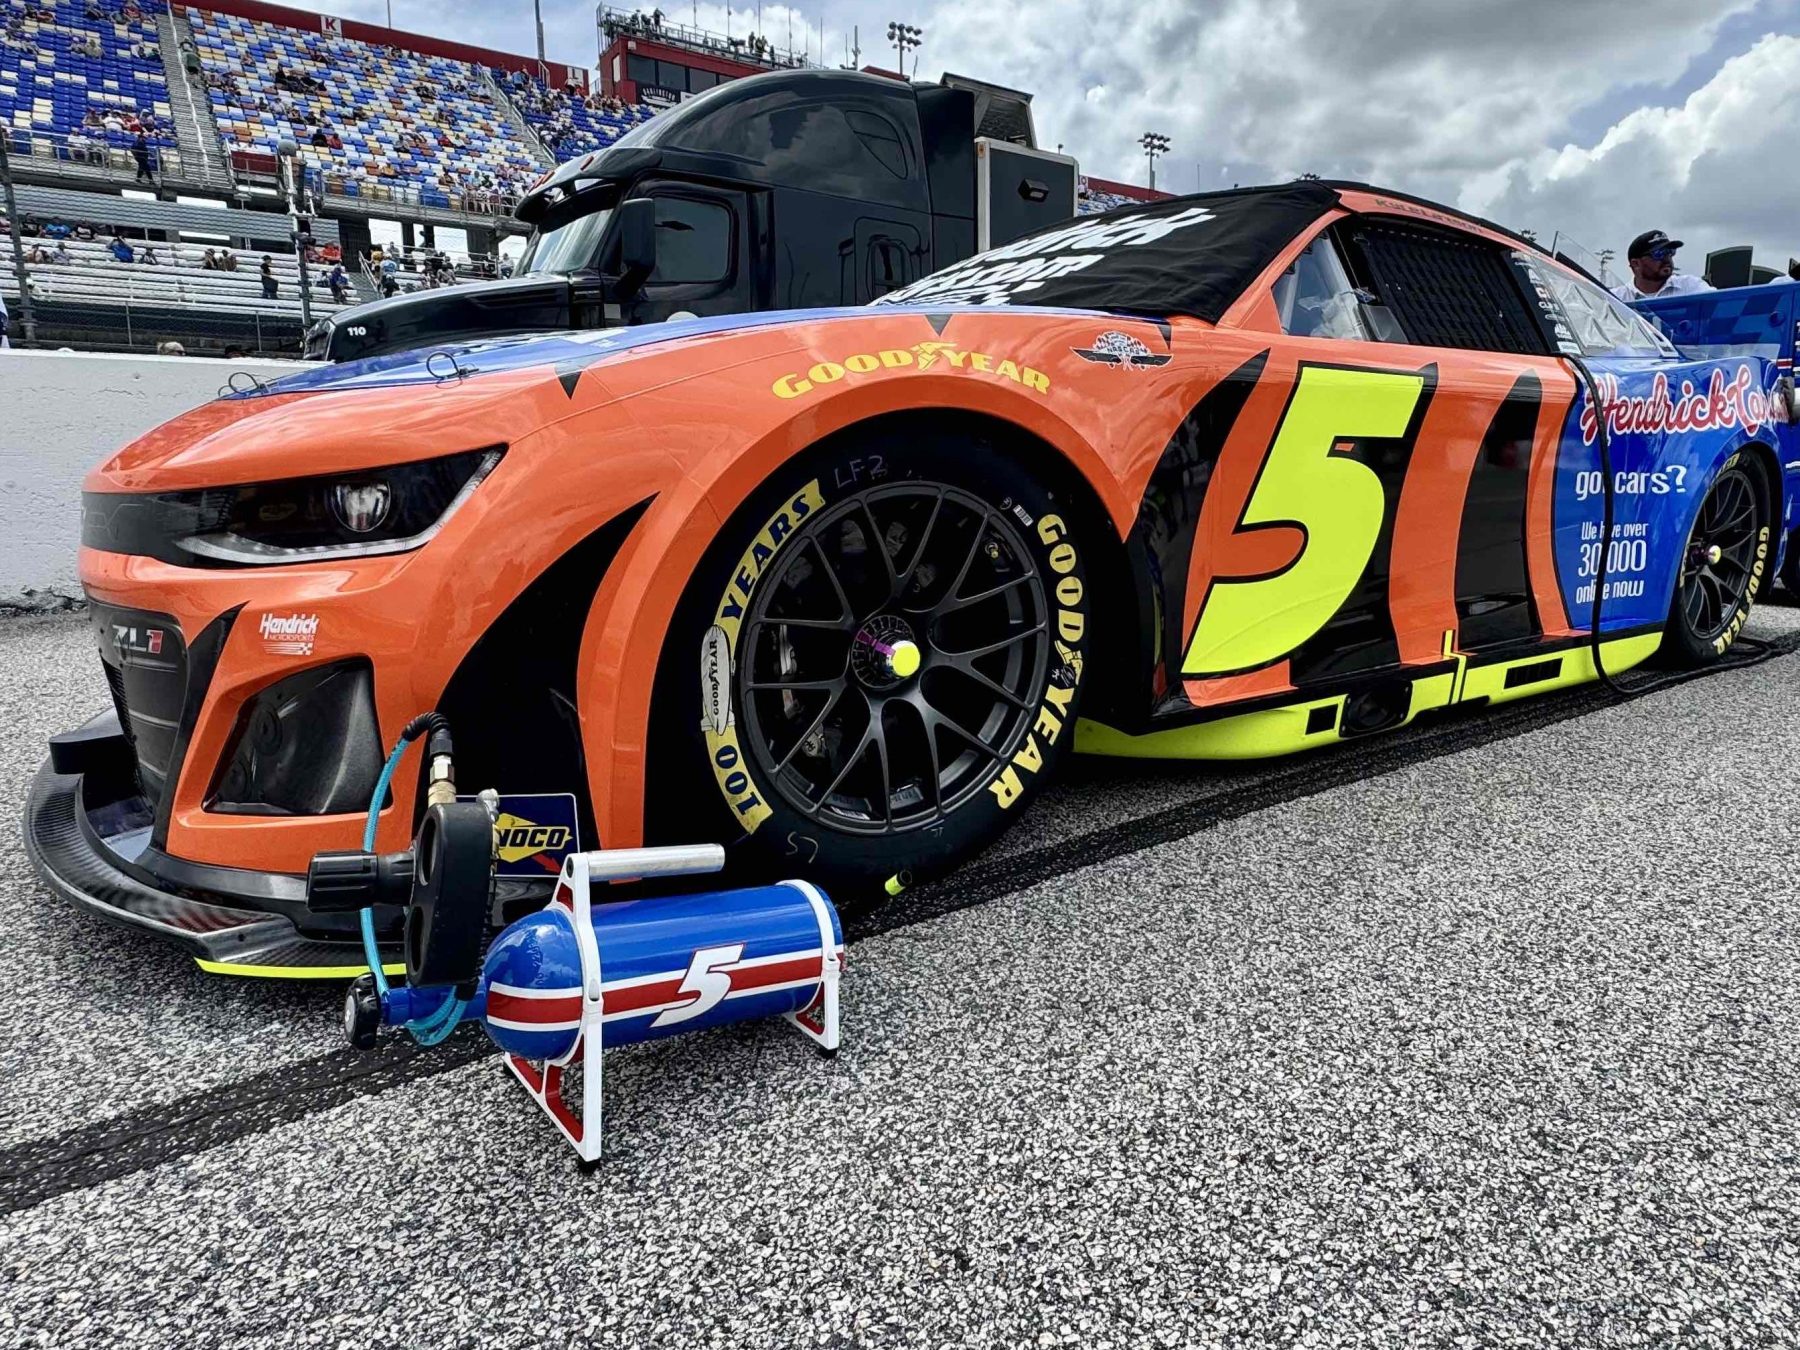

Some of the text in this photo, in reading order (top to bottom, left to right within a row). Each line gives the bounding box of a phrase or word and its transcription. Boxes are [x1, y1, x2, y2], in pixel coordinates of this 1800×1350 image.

[325, 17, 337, 31] K
[347, 326, 367, 336] 110
[771, 342, 1051, 399] GOODYEAR
[1575, 464, 1687, 501] go cars?
[1180, 366, 1424, 674] 5
[1581, 520, 1649, 540] We hve over
[720, 493, 811, 622] YEARS
[1576, 579, 1644, 604] onlie now
[1713, 526, 1770, 656] GOODYEAR
[259, 613, 319, 640] Hendrick
[270, 634, 314, 642] MOTORSPORTS
[711, 639, 720, 716] GOODYEAR
[988, 514, 1084, 809] GOODYEAR
[714, 745, 761, 816] 100
[499, 828, 566, 848] NOCO
[650, 944, 744, 1028] 5
